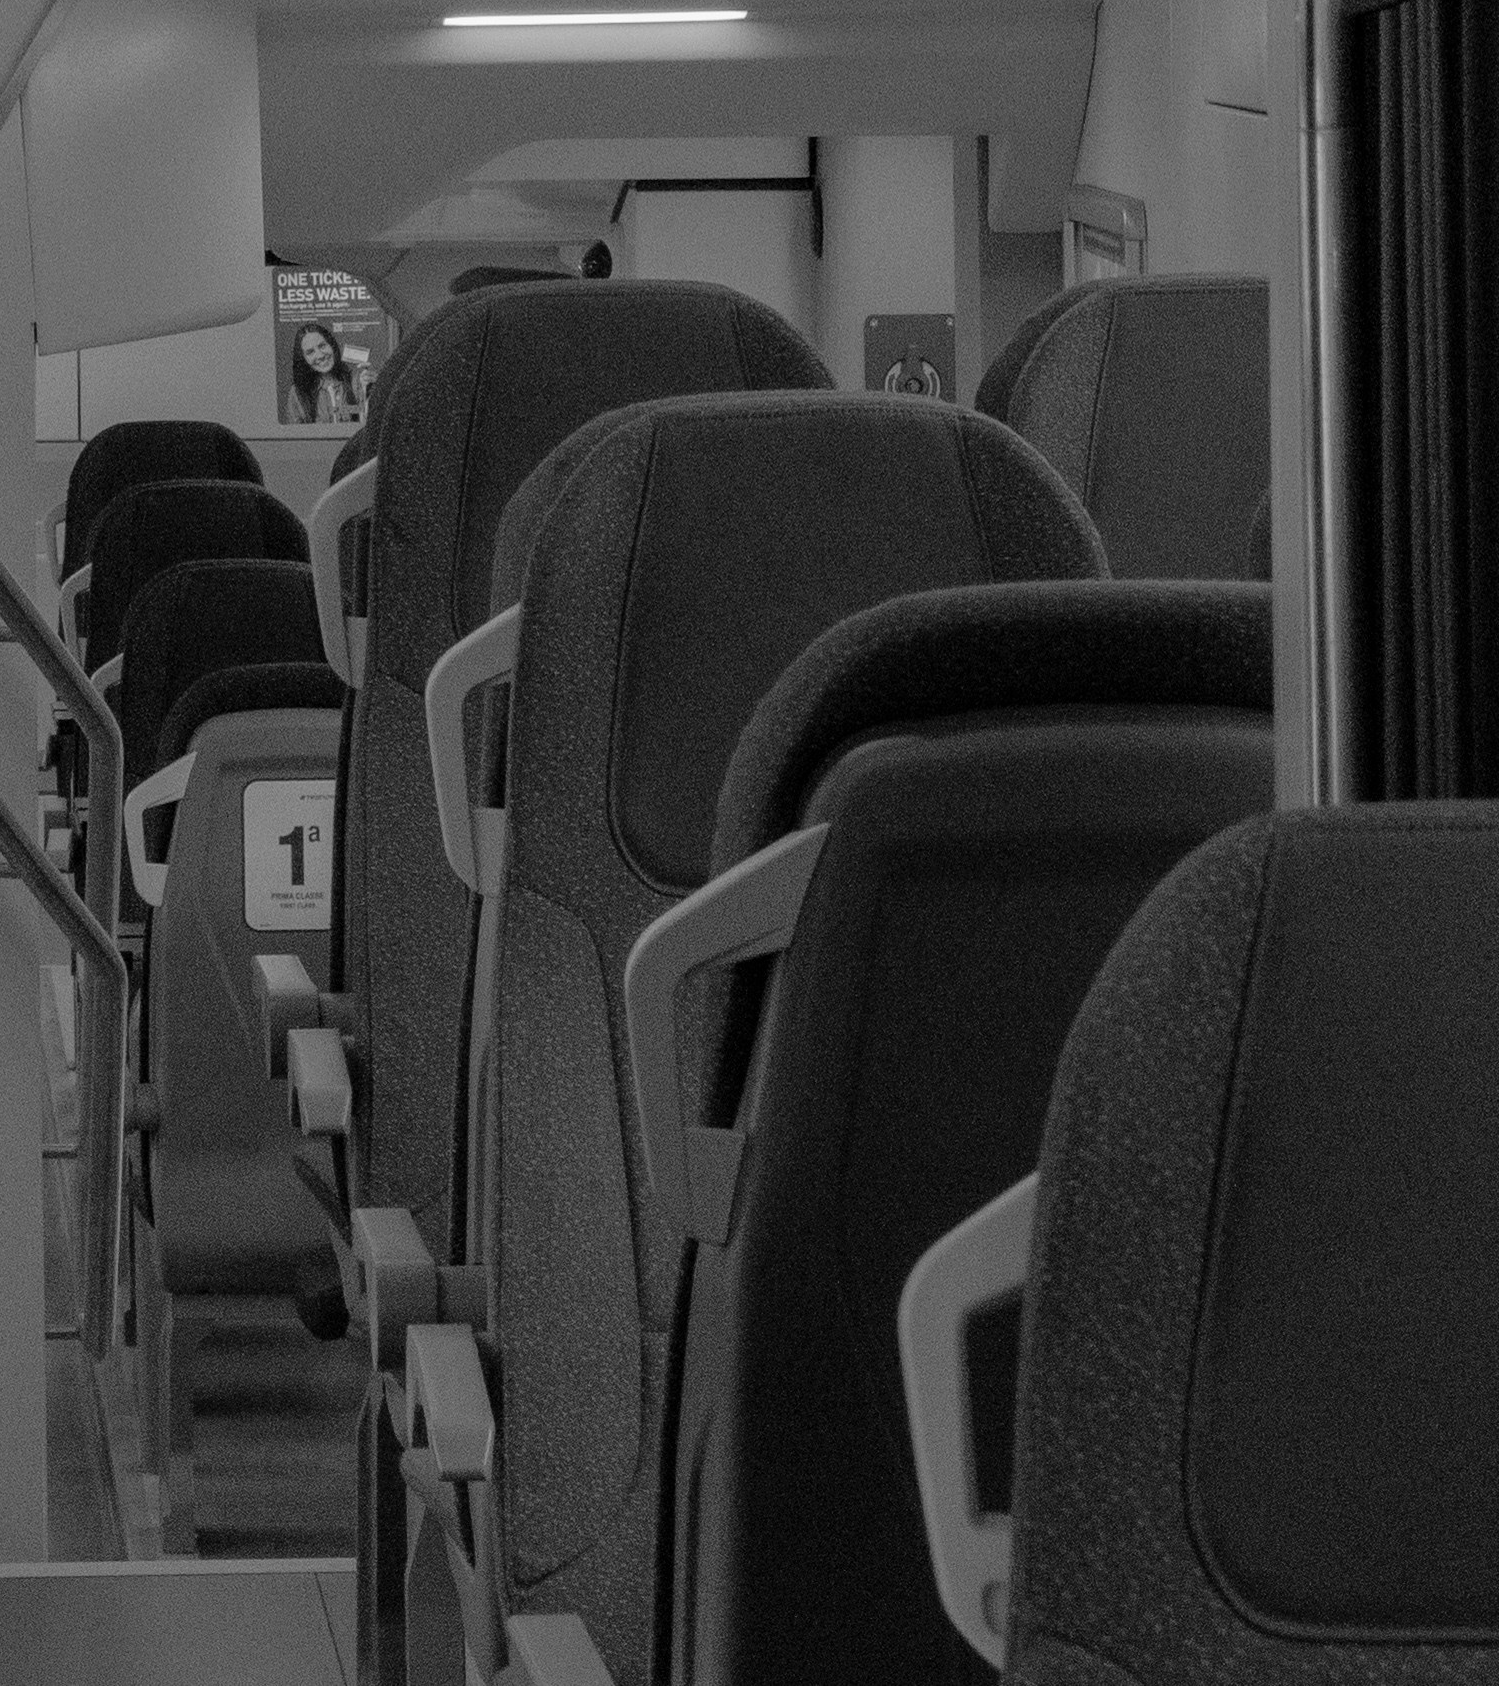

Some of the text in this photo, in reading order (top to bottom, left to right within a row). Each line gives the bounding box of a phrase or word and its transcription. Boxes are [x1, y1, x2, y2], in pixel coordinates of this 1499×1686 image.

[278, 273, 308, 287] ONE
[278, 286, 371, 302] LESS WASTE.
